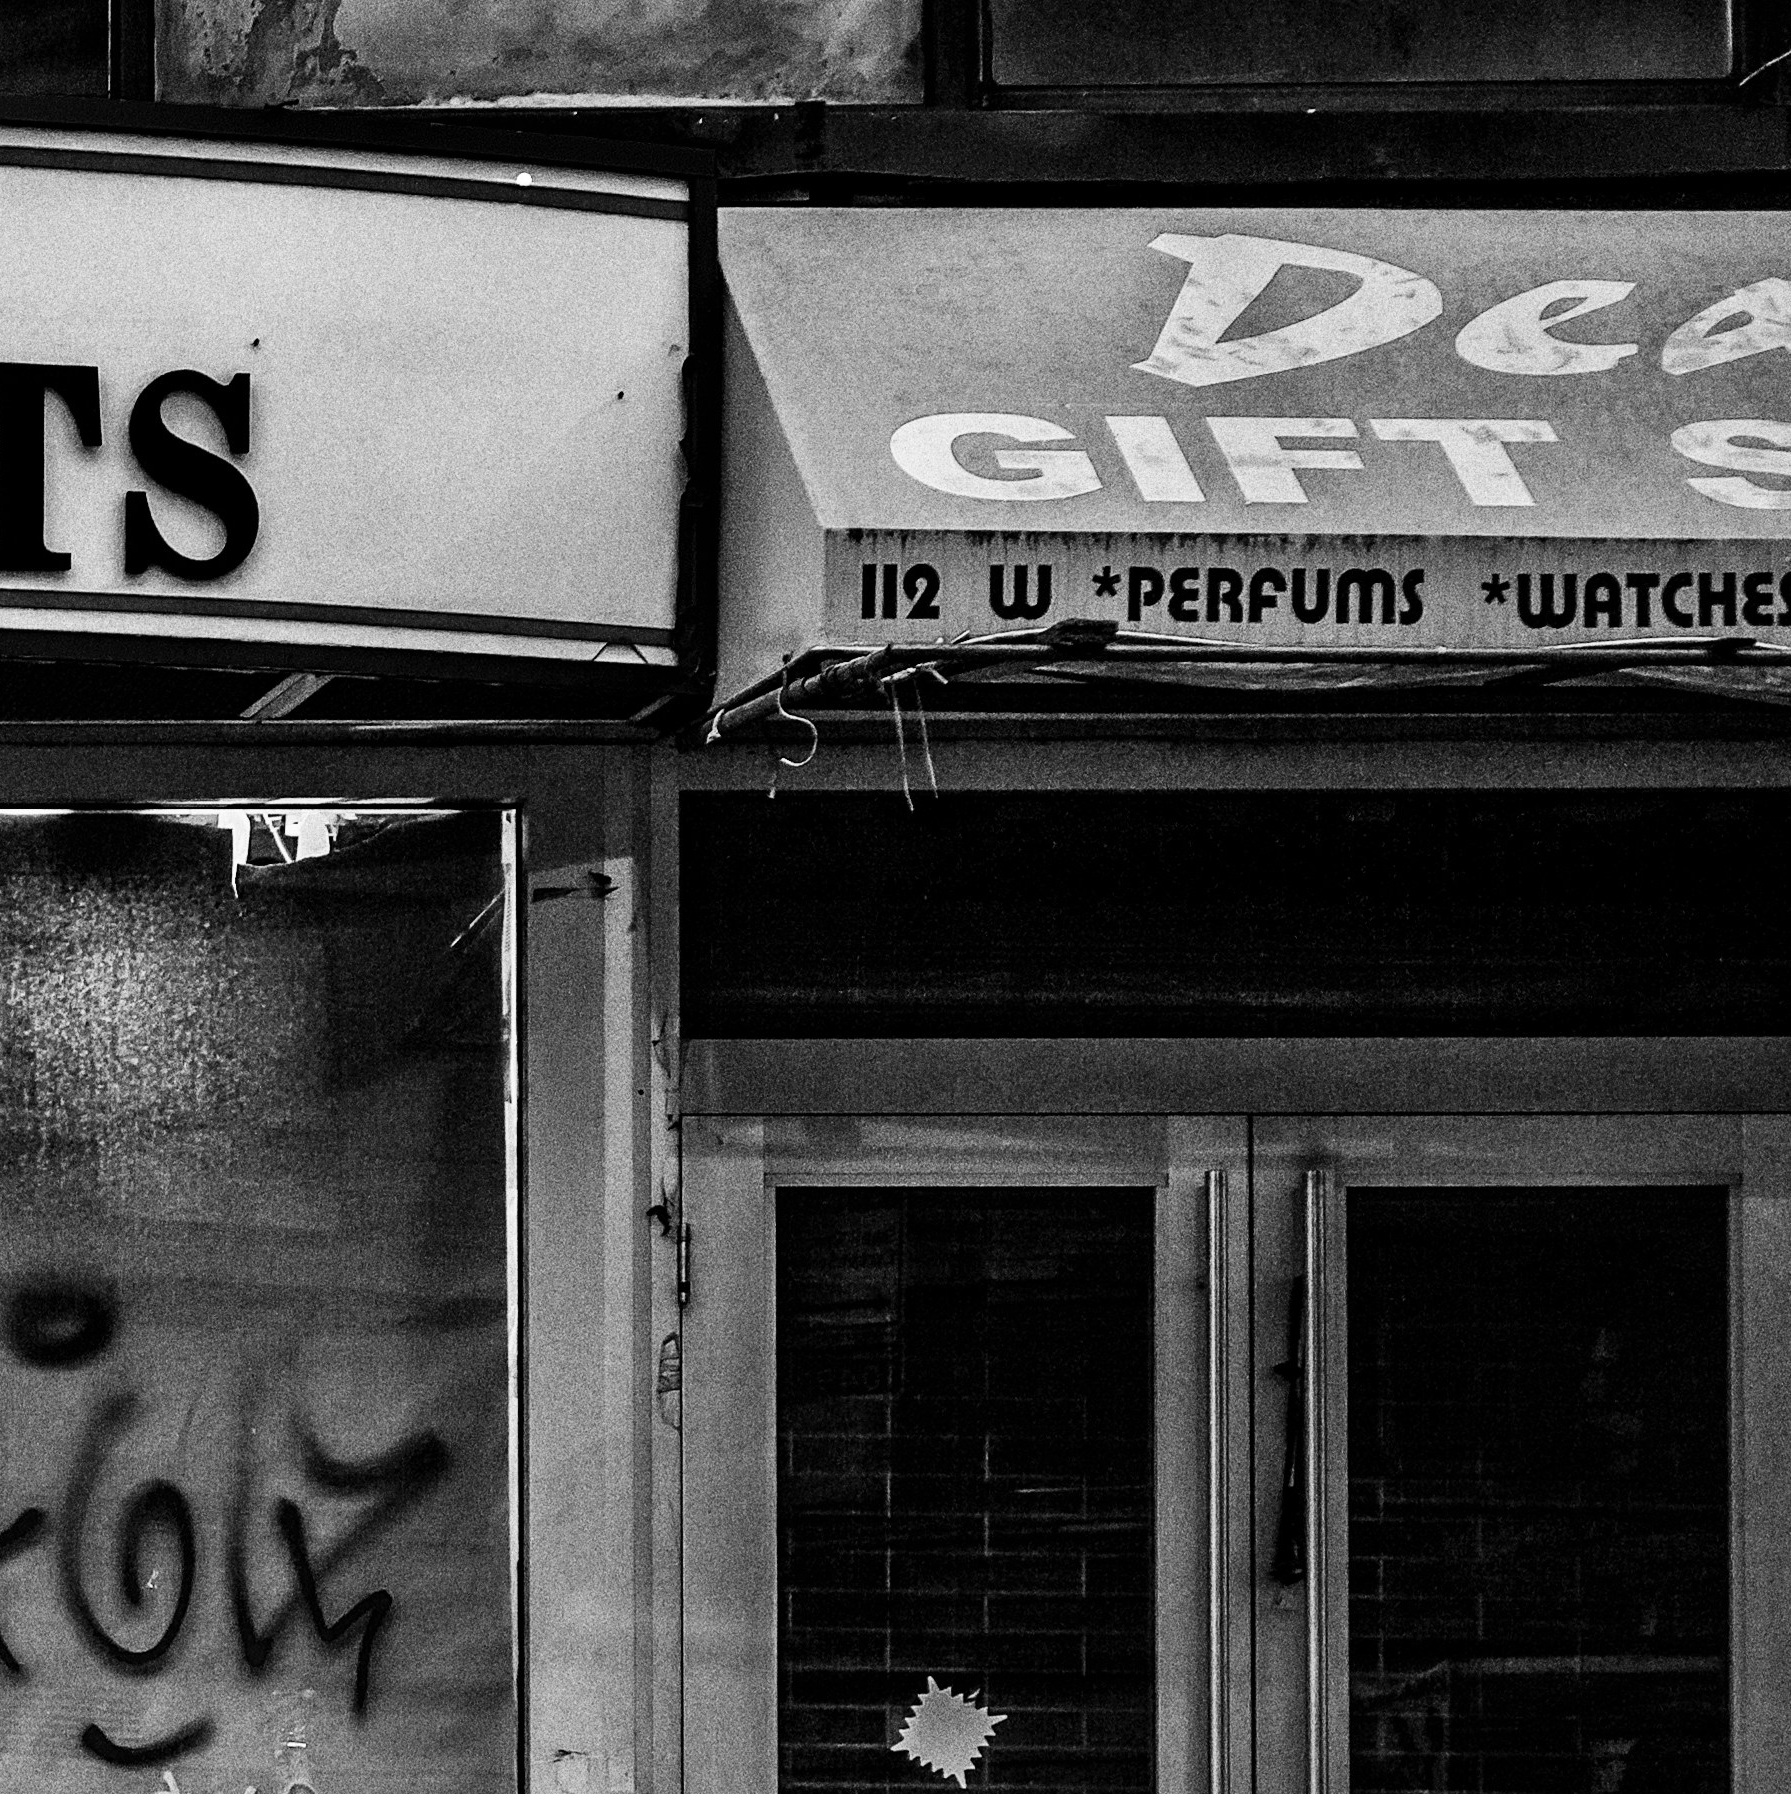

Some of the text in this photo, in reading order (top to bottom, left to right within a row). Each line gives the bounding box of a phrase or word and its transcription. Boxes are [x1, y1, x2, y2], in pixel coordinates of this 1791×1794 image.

[889, 412, 1561, 508] GIFT
[861, 563, 941, 621] 112
[987, 563, 1054, 621] W
